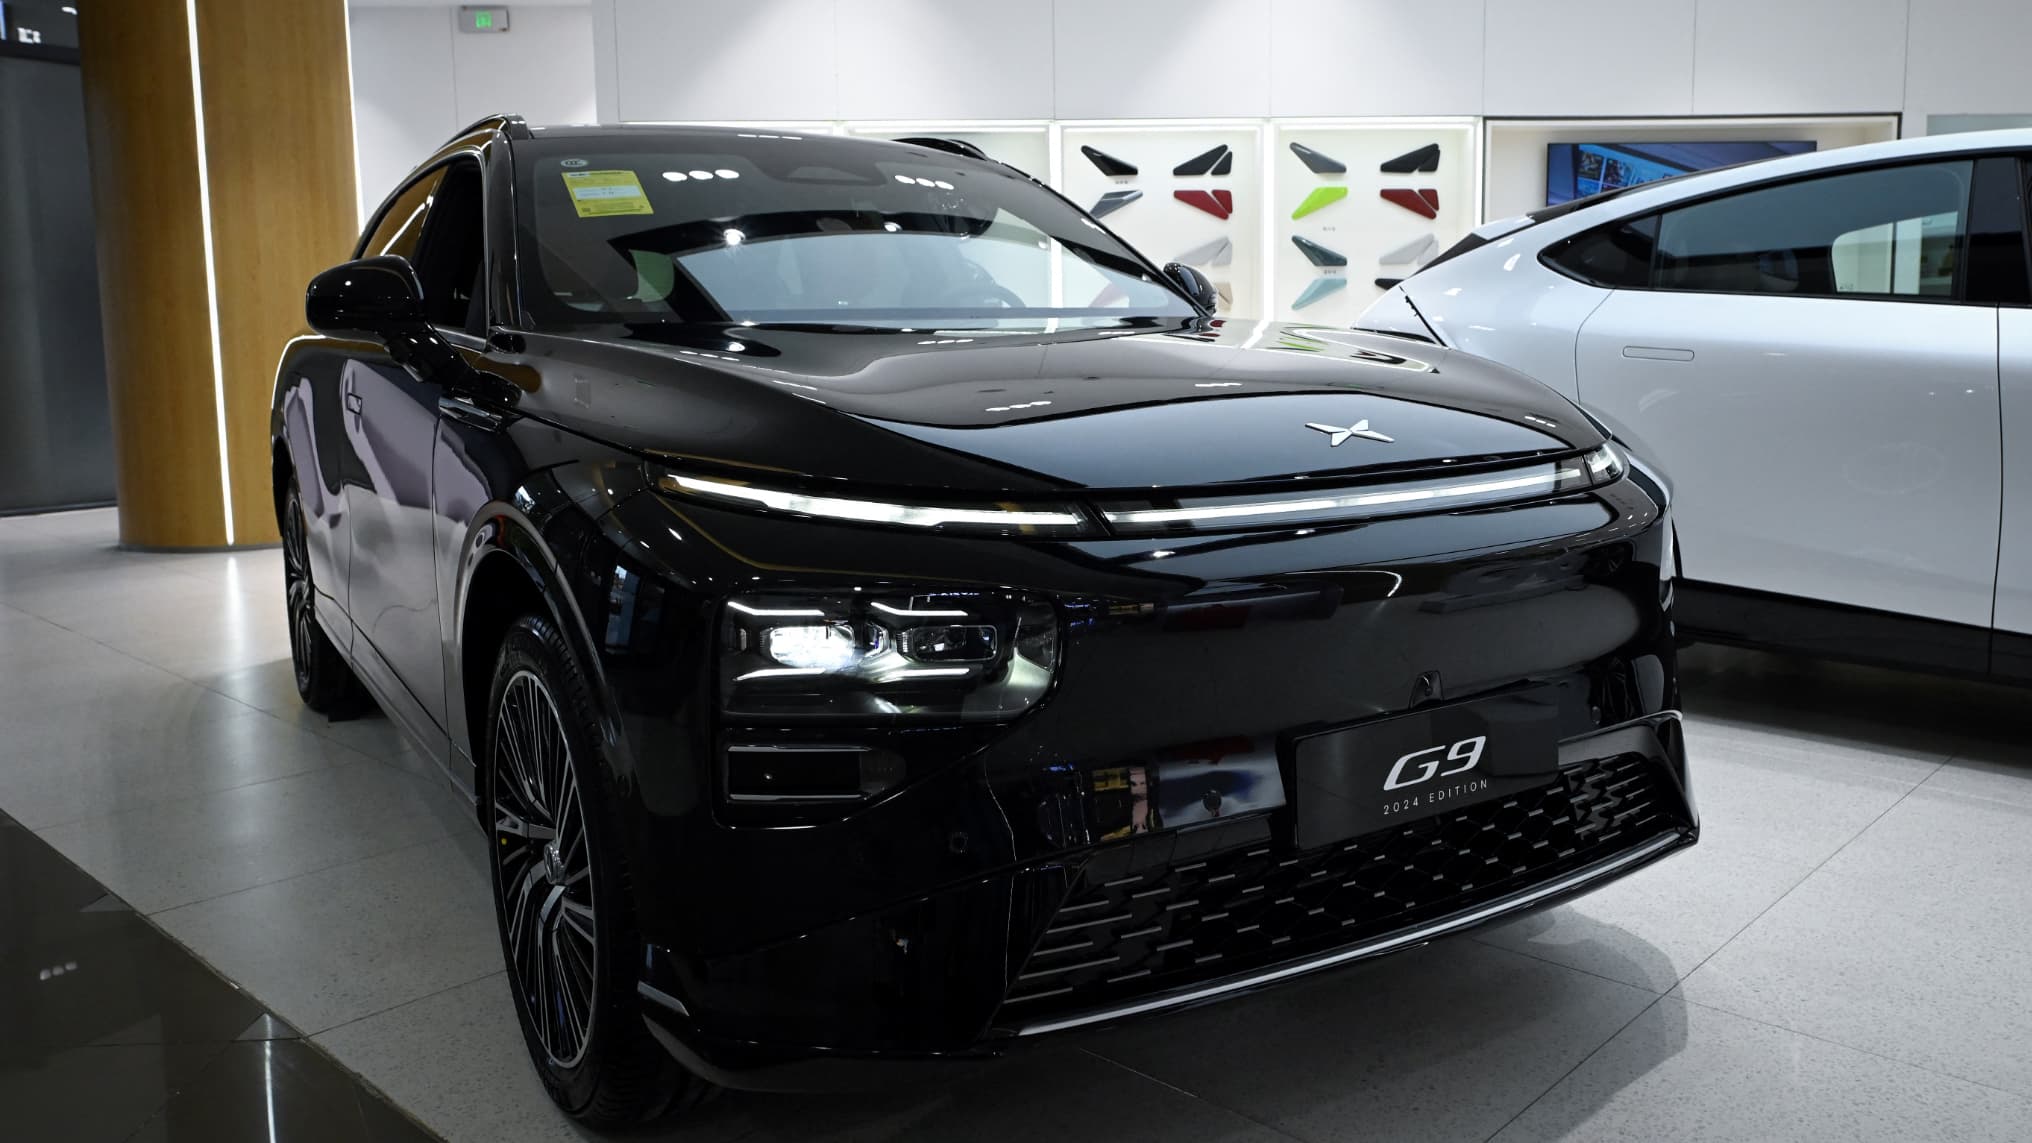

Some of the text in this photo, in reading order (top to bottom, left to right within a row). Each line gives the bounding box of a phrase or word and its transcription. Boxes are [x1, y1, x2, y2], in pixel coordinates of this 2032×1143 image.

[1383, 735, 1487, 791] G9
[1383, 778, 1487, 815] 2024 EDITION
